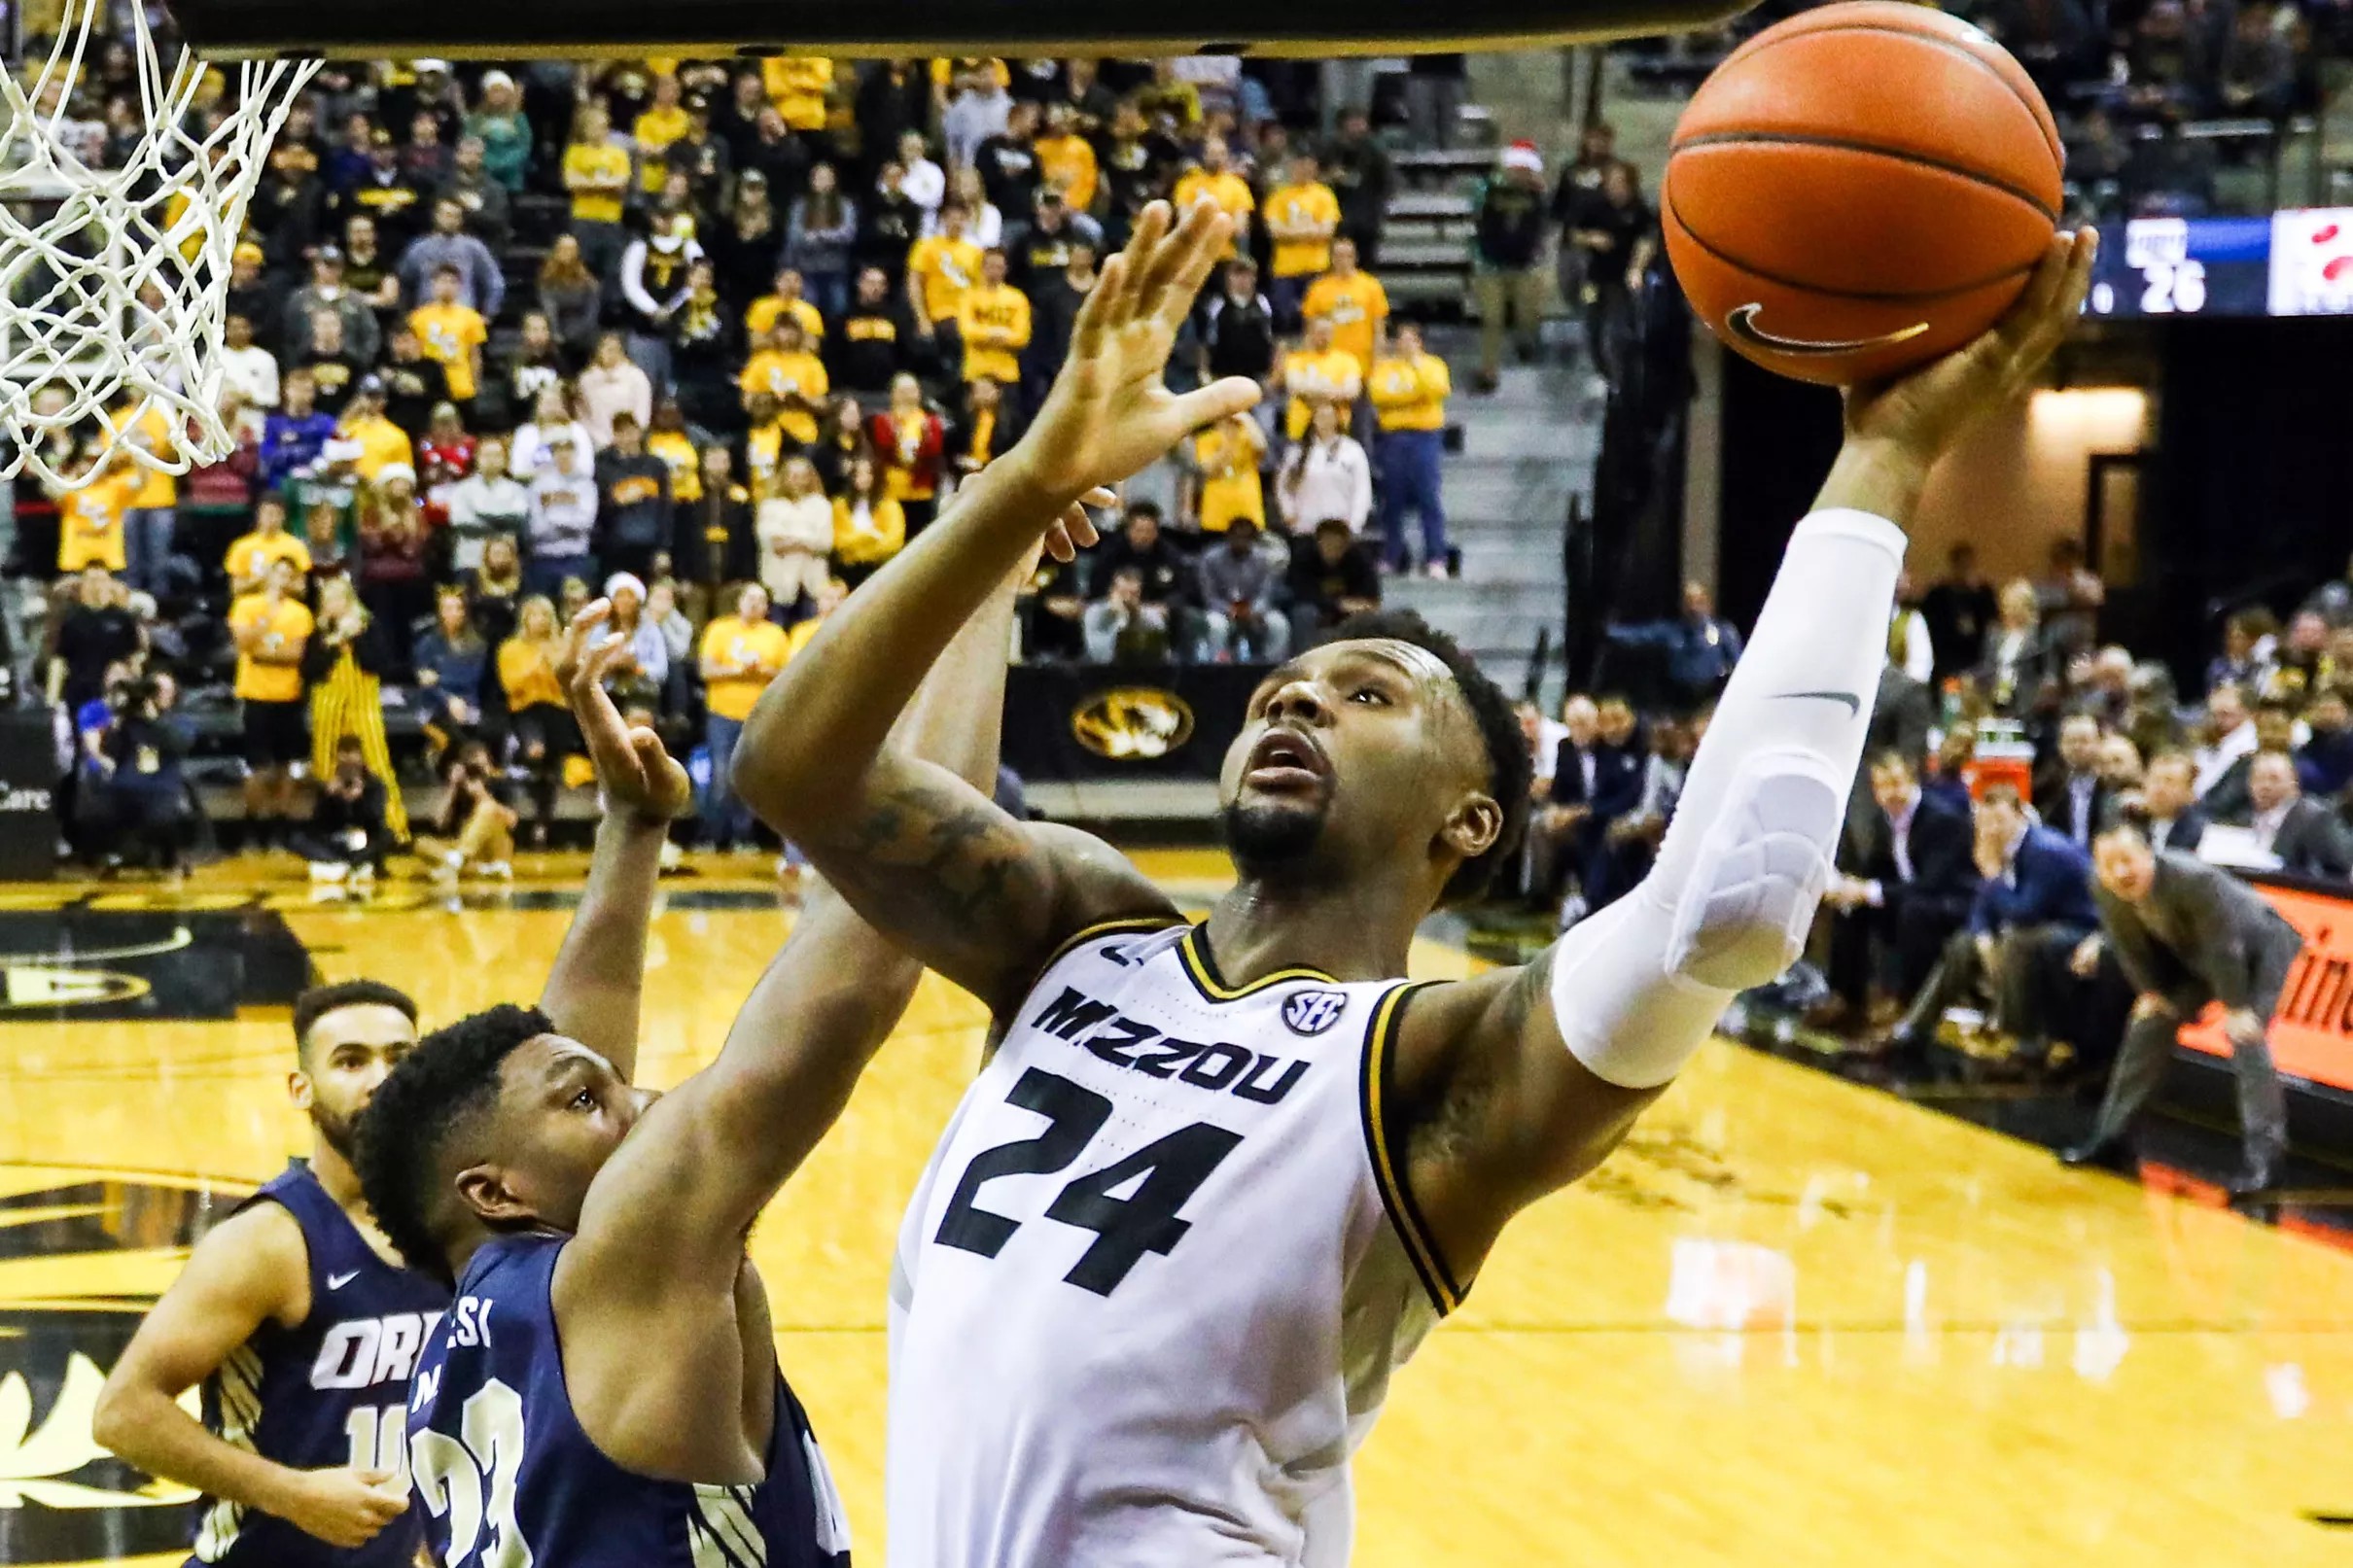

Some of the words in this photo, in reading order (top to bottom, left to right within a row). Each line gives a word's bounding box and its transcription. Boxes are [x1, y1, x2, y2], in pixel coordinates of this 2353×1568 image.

[2141, 260, 2205, 313] 26
[1031, 986, 1312, 1104] MZZOU
[1283, 992, 1348, 1033] SEC
[933, 1065, 1245, 1298] 24
[345, 1404, 413, 1498] 10
[409, 1377, 534, 1568] 23
